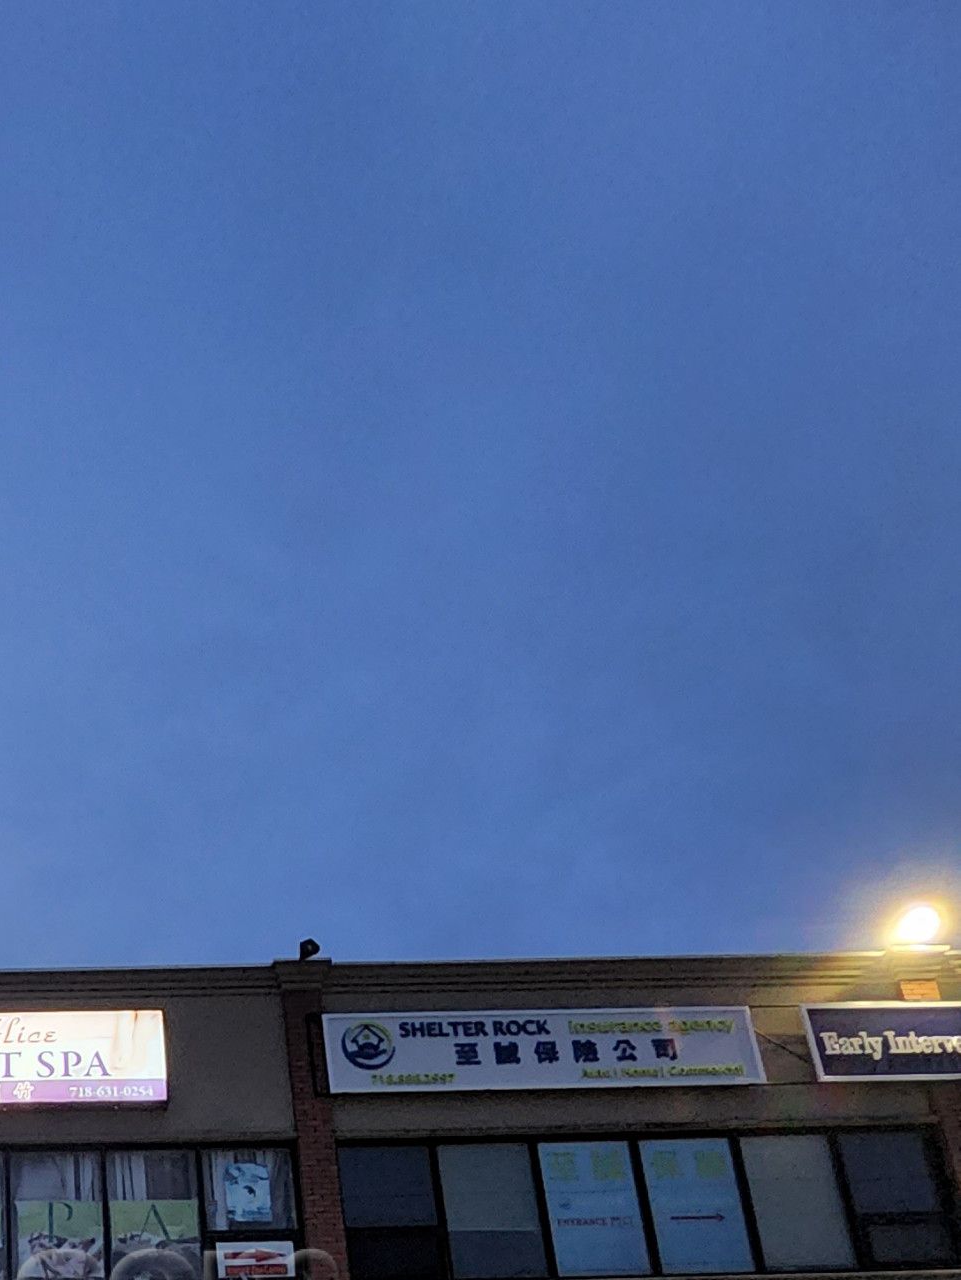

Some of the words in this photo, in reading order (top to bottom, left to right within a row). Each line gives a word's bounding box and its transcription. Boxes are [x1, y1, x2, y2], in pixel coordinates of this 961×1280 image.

[399, 1020, 488, 1038] SHELTER
[492, 1019, 551, 1036] ROCK
[568, 1020, 662, 1035] Insurance
[819, 1031, 883, 1060] Early
[37, 1050, 113, 1079] SPA
[69, 1085, 154, 1098] 718-631-0254
